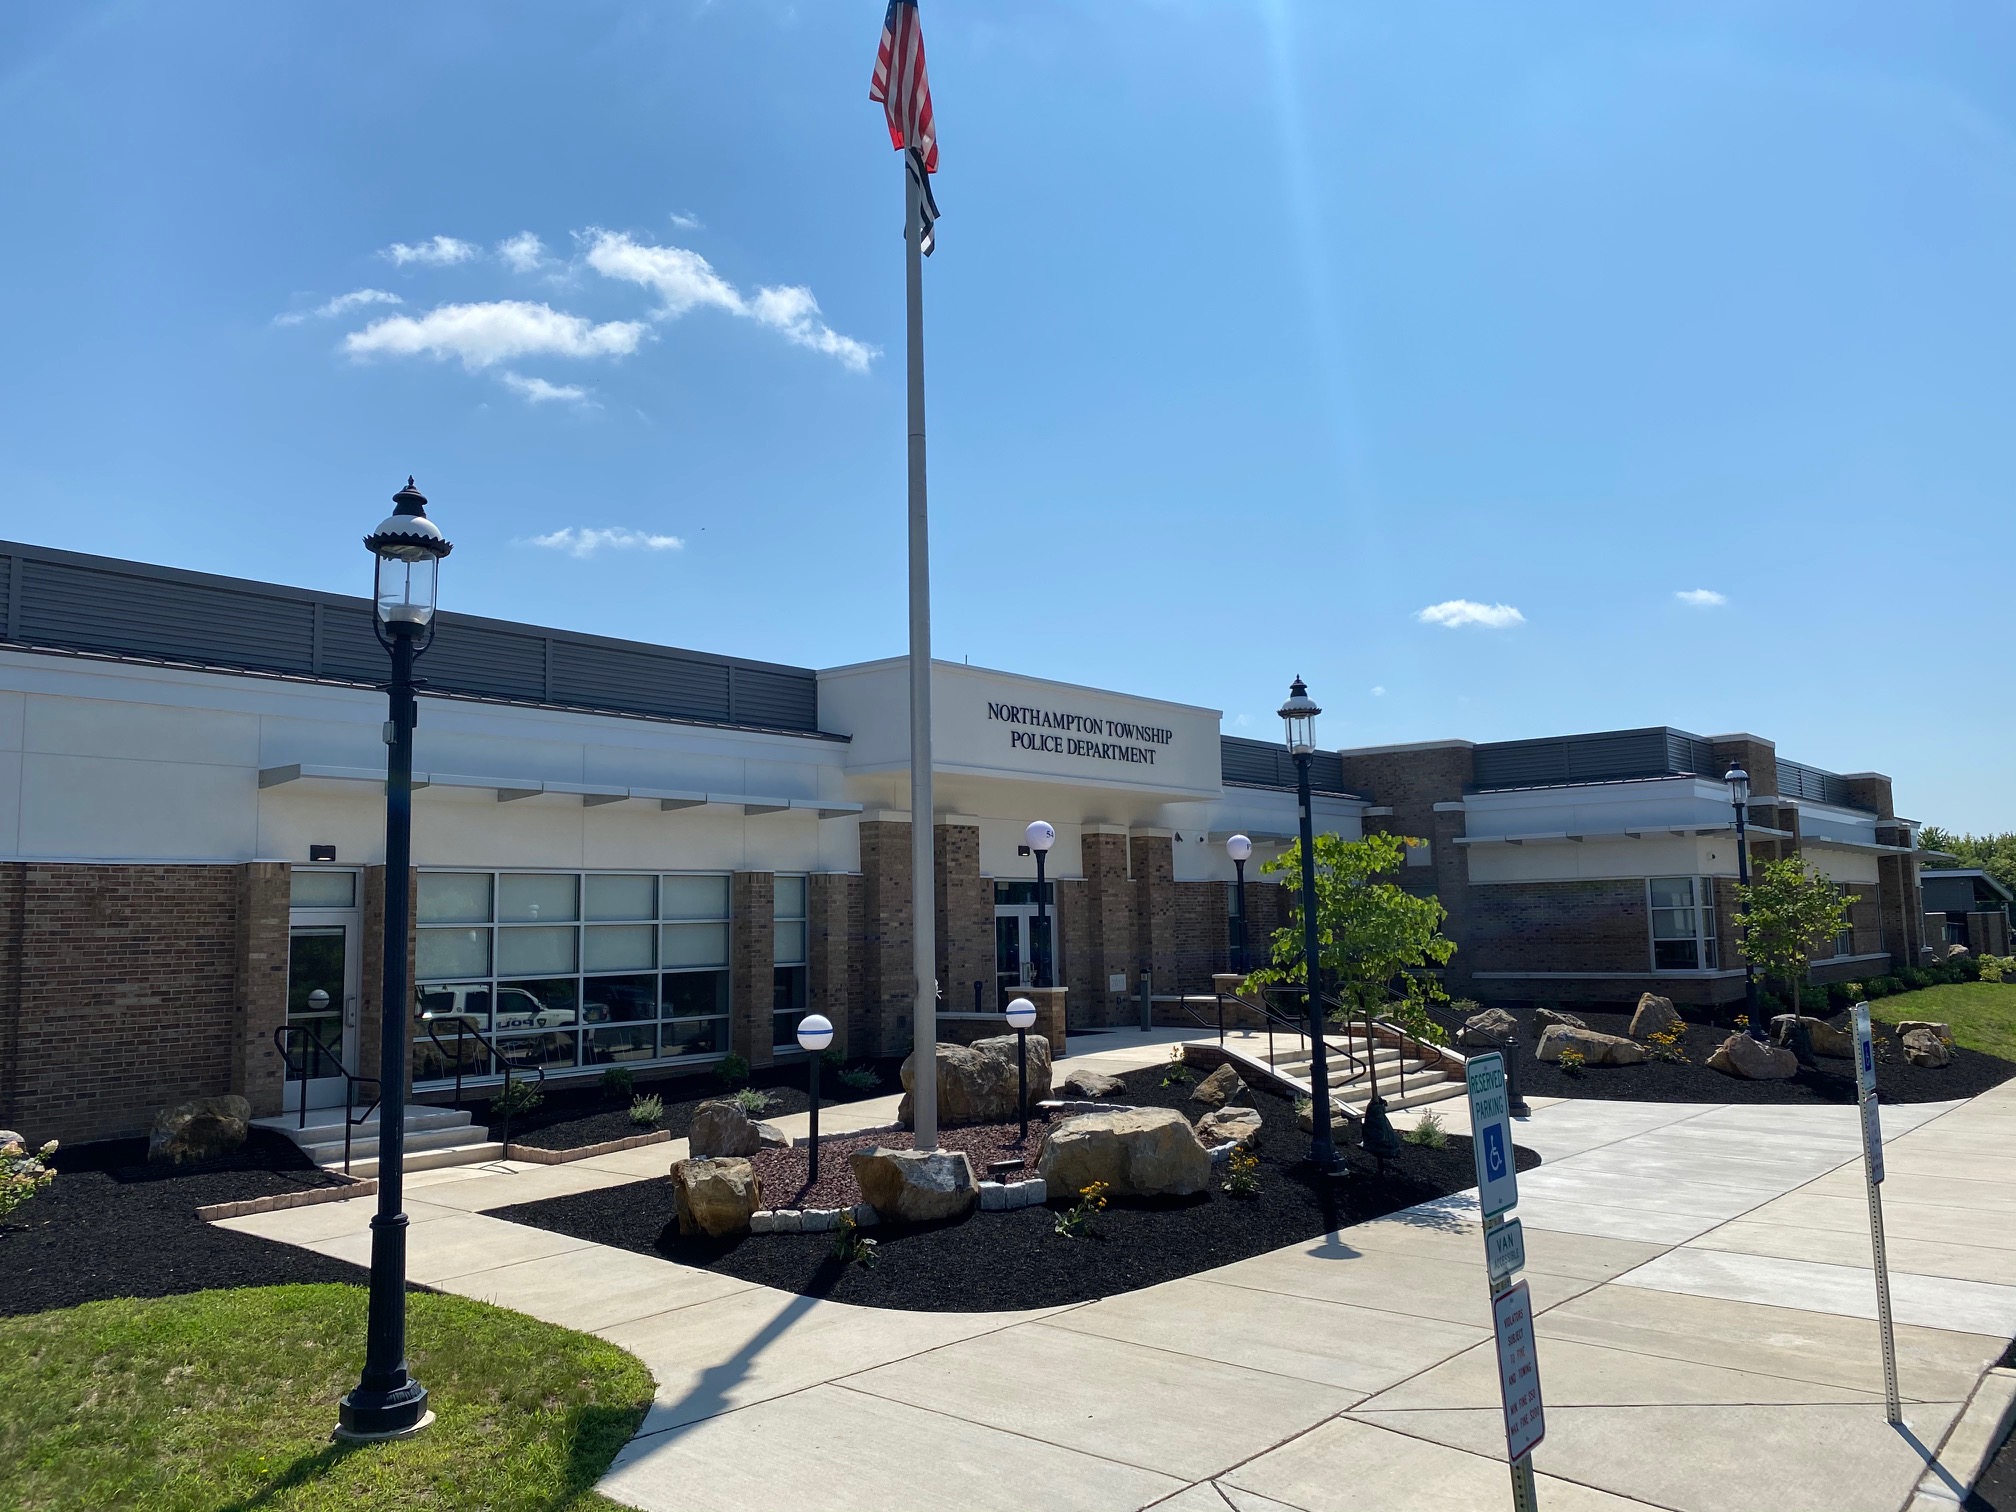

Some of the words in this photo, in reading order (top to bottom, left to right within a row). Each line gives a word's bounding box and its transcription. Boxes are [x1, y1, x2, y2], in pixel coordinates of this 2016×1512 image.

[988, 702, 1104, 735] NORTHAMPTON
[1106, 721, 1173, 745] TOWNSHIP
[1010, 731, 1064, 753] POLICE
[1067, 738, 1157, 765] DEPARTMENT
[1470, 1069, 1503, 1095] RESERVED
[1475, 1095, 1504, 1120] PARKING
[1496, 1232, 1514, 1253] VAN
[1494, 1247, 1520, 1269] ACCESSIBLE
